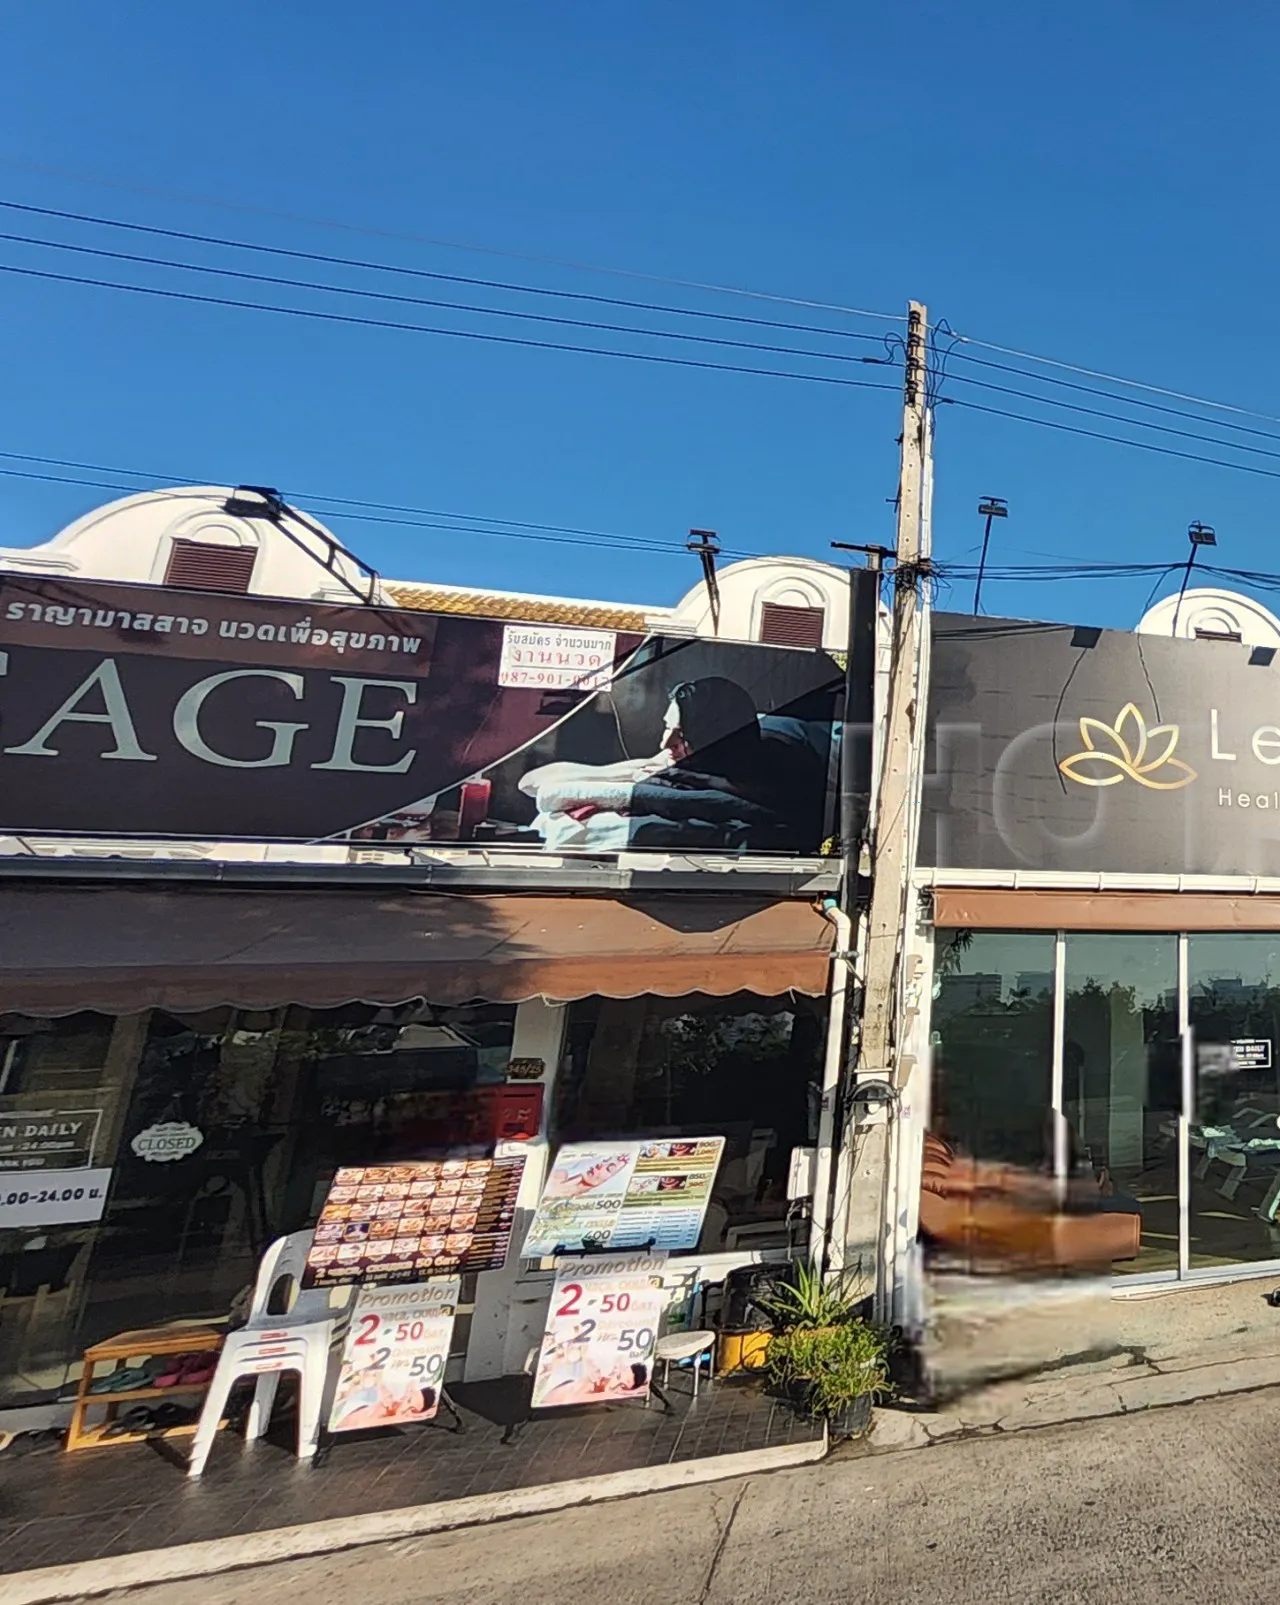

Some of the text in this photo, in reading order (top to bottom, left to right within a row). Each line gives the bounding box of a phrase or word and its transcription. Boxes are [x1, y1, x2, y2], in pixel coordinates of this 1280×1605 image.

[218, 617, 422, 654] นวดเพื่อสุขภาพ
[0, 651, 418, 773] AGE
[24, 1122, 83, 1137] DAILY
[137, 1136, 197, 1151] CLOSED
[595, 1199, 621, 1210] 500
[559, 1255, 664, 1277] Promotion
[359, 1286, 456, 1308] Promotion
[556, 1283, 583, 1317] 2
[599, 1292, 632, 1314] 50
[353, 1313, 381, 1347] 2
[394, 1321, 425, 1342] 50
[616, 1327, 653, 1352] 50
[408, 1353, 444, 1377] 50
